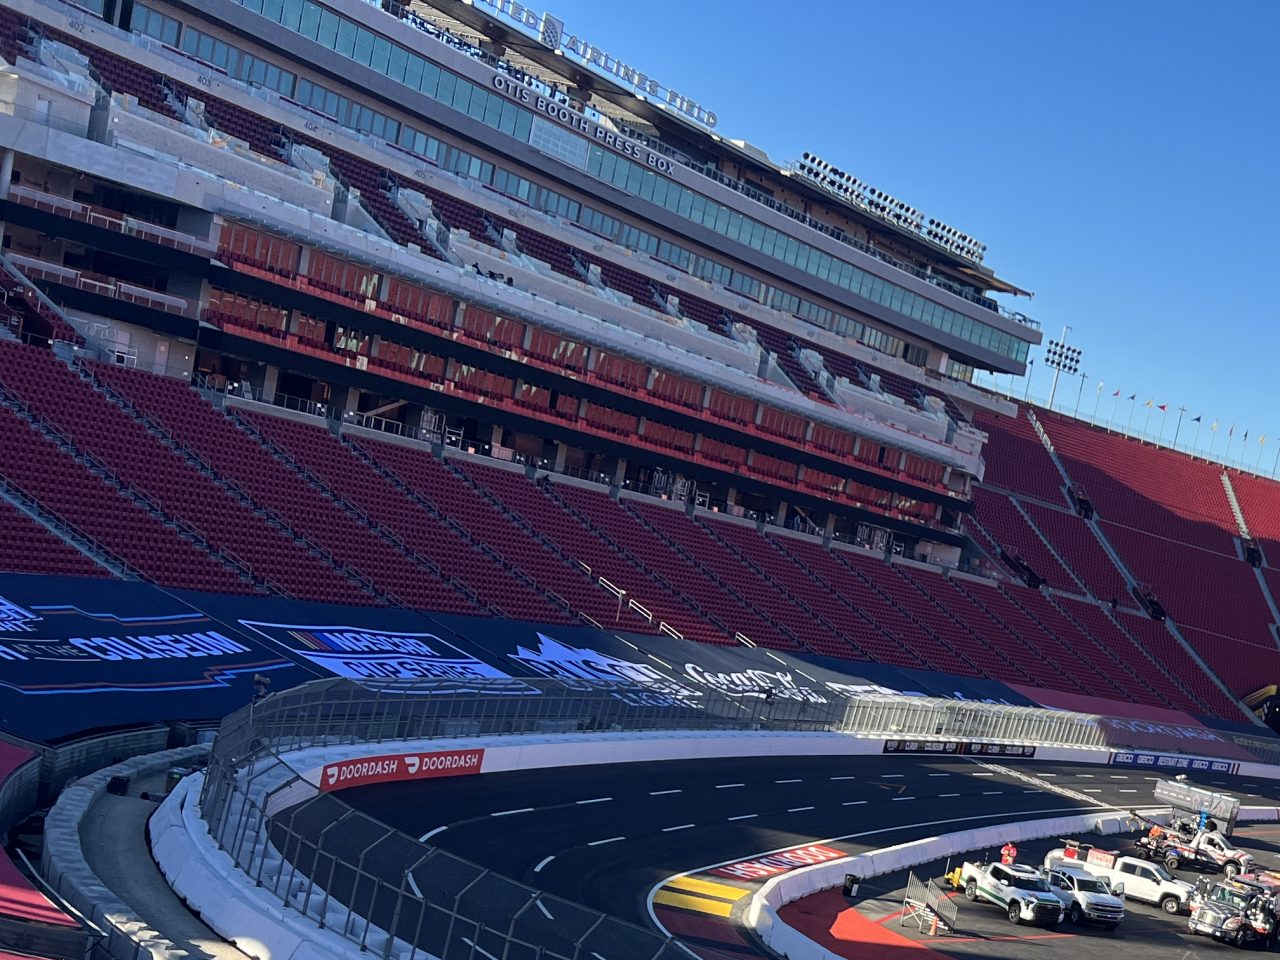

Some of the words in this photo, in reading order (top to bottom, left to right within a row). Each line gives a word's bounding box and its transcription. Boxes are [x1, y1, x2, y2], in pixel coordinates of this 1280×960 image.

[565, 36, 660, 97] AIRLINES
[666, 89, 719, 128] FIELD
[493, 75, 530, 103] OTIS
[535, 97, 589, 133] BOOTH
[594, 127, 642, 160] PRESS
[647, 153, 676, 176] BOX
[69, 630, 252, 661] COLISEUM
[324, 631, 441, 657] NASCAR
[342, 660, 398, 679] CUP
[400, 660, 487, 679] SERIES
[340, 760, 398, 780] DOORDASH
[422, 754, 479, 770] DOORDASH
[1116, 753, 1134, 763] GEICO
[1137, 755, 1155, 764] GEICO
[1192, 760, 1209, 769] GEICO
[1211, 762, 1228, 771] GEICO
